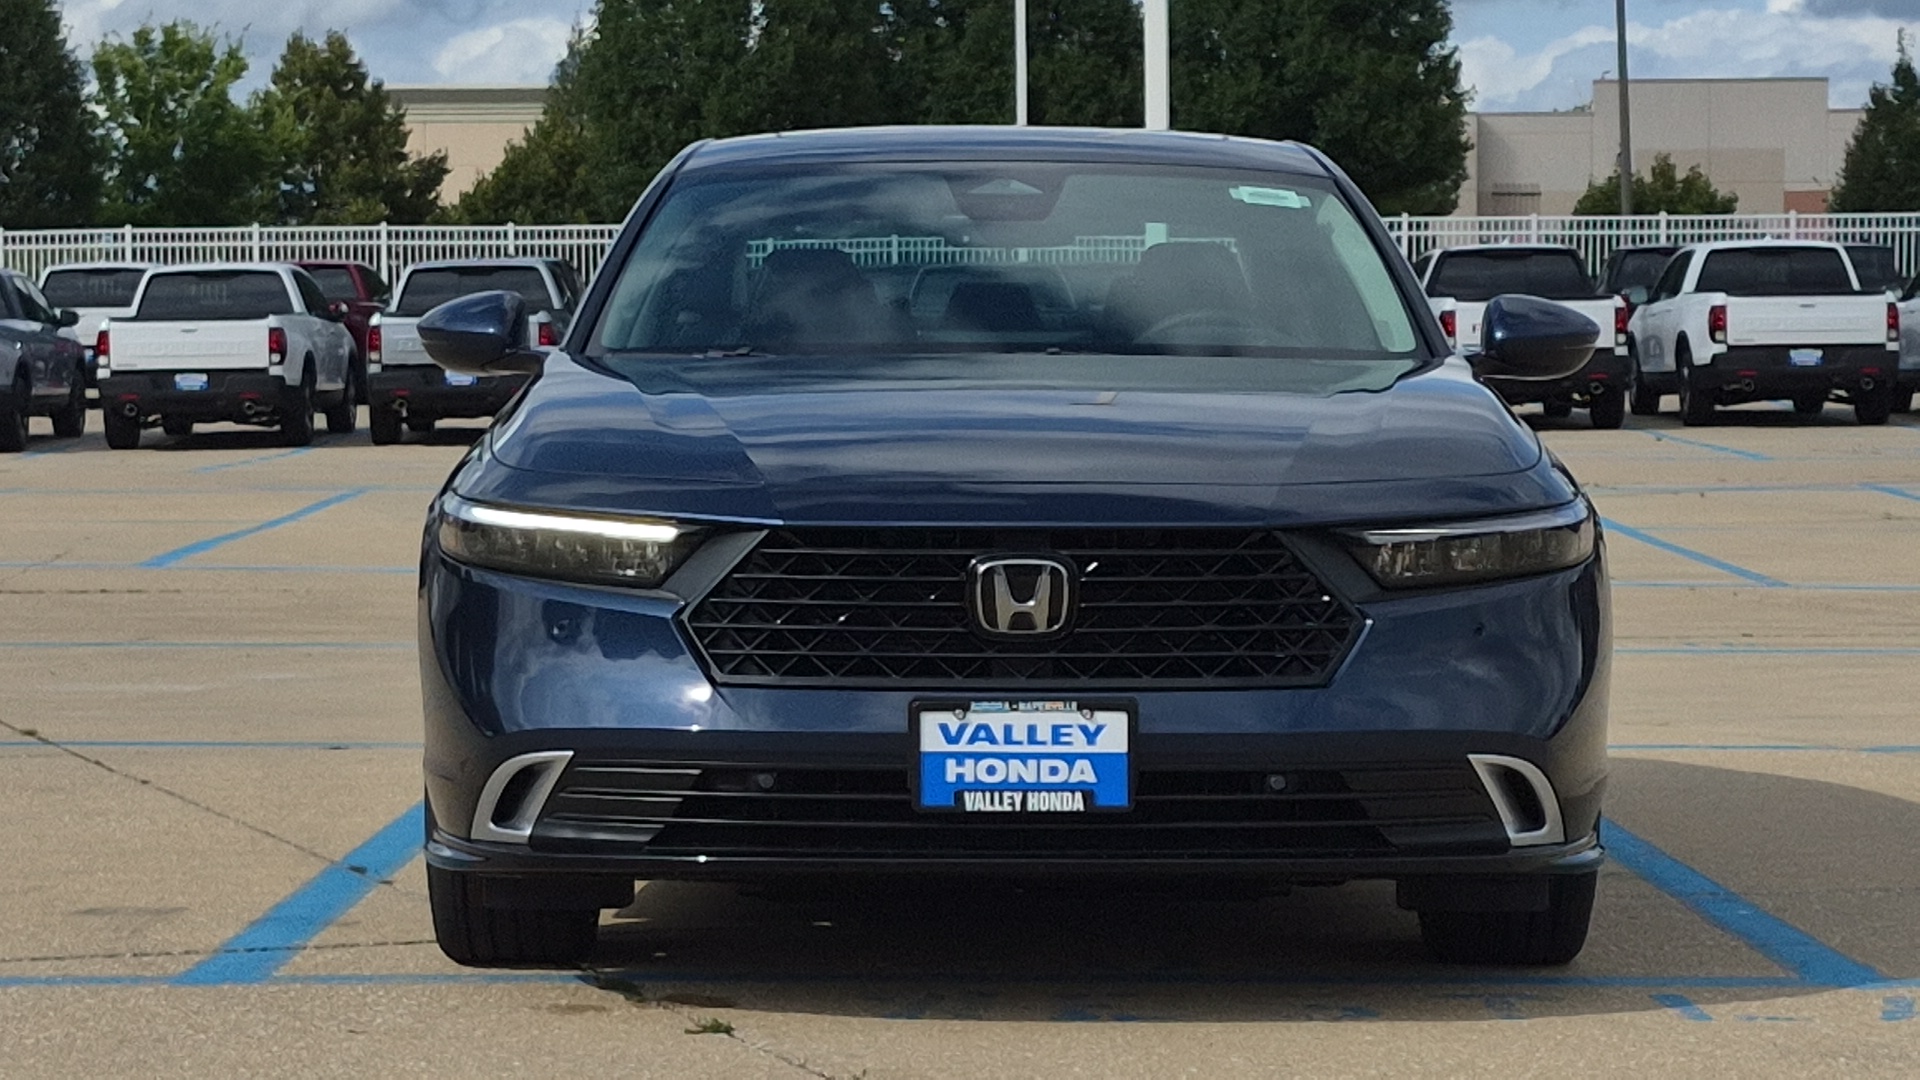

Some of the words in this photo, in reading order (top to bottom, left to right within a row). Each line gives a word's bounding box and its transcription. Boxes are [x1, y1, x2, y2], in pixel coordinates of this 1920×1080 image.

[938, 723, 1107, 746] VALLEY
[945, 758, 1097, 783] HONDA
[964, 791, 1023, 812] VALLEY
[1027, 791, 1085, 812] HONDA
